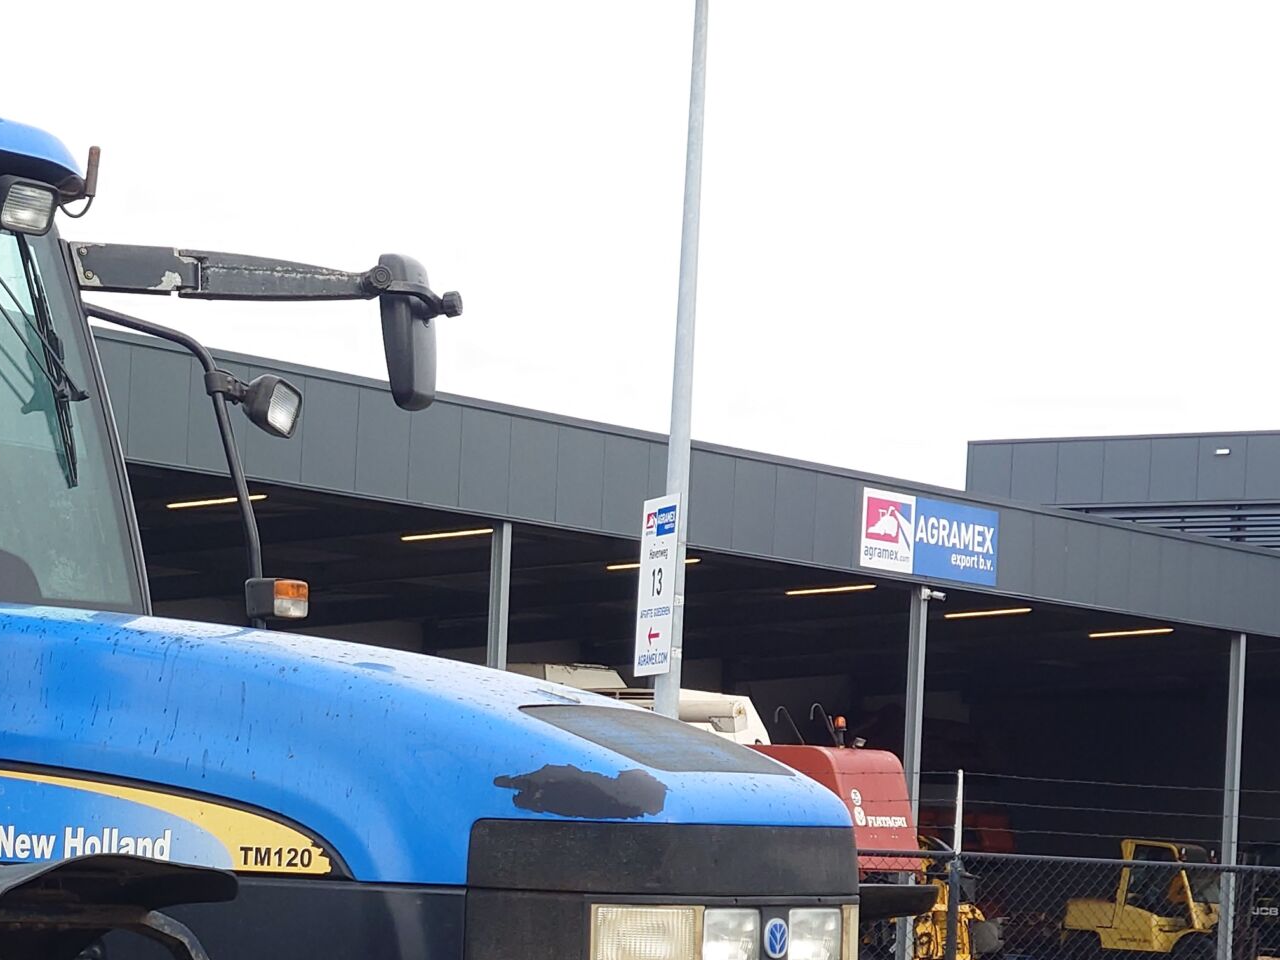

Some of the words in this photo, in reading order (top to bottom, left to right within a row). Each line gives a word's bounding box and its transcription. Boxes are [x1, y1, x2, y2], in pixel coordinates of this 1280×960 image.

[916, 515, 994, 554] AGRAMEX
[951, 554, 978, 569] export
[979, 555, 993, 570] b.v.
[651, 567, 663, 597] 13
[64, 826, 172, 861] Holland
[239, 846, 312, 868] TM120
[1251, 906, 1279, 916] JCB
